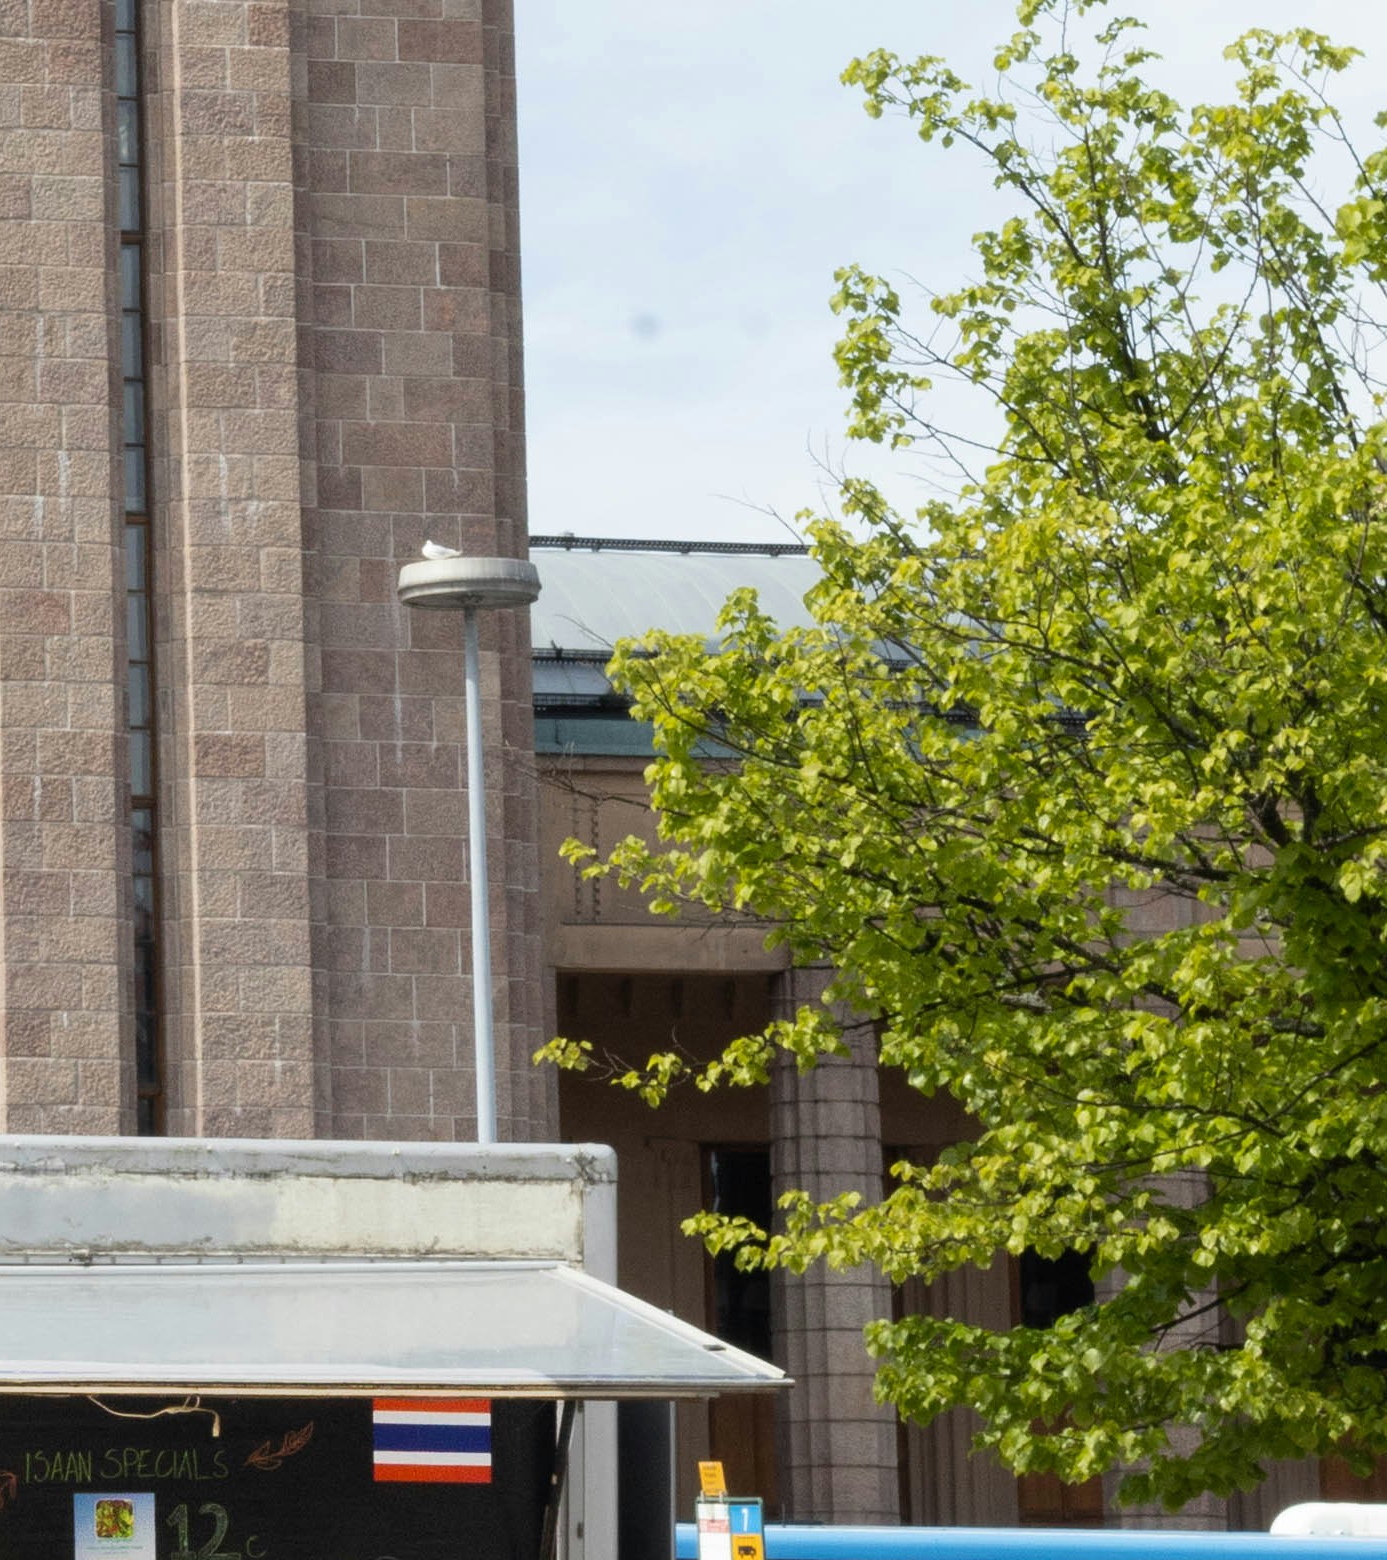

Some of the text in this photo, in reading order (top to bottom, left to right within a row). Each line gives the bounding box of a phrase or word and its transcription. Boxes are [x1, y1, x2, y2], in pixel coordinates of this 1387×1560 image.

[24, 1448, 230, 1484] ISAAN SPECIALS
[740, 1507, 750, 1532] 1
